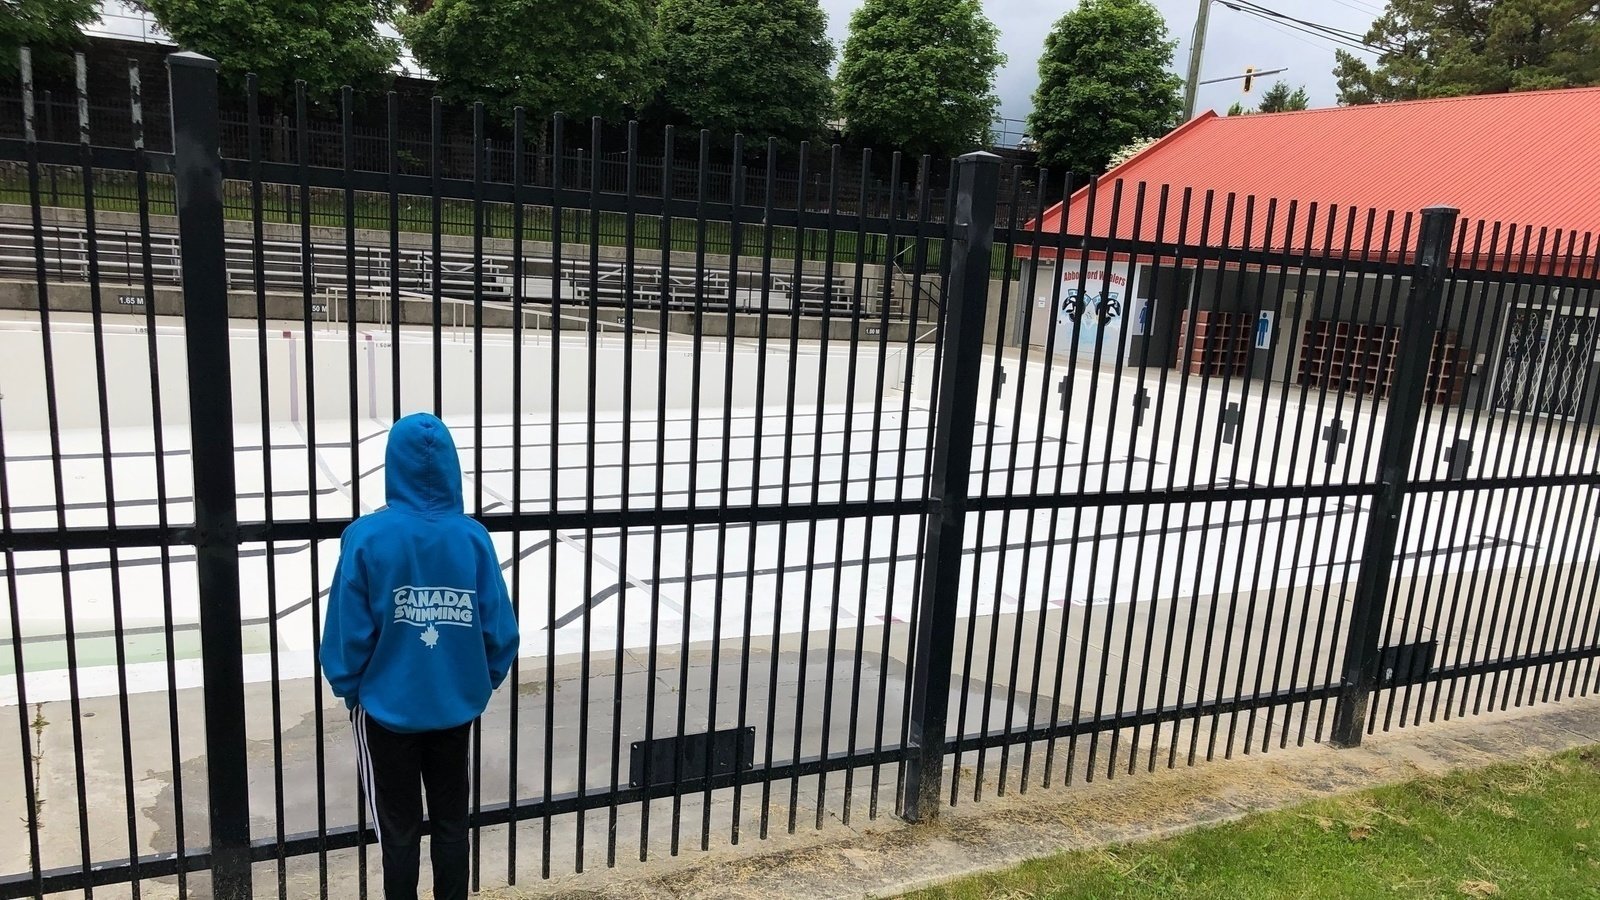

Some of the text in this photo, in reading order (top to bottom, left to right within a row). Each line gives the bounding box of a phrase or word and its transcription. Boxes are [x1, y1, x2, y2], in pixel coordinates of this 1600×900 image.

[1064, 270, 1098, 282] Abboord
[119, 296, 144, 305] 1.65 M
[394, 590, 473, 610] CANADA
[394, 605, 472, 622] SWIMMING
